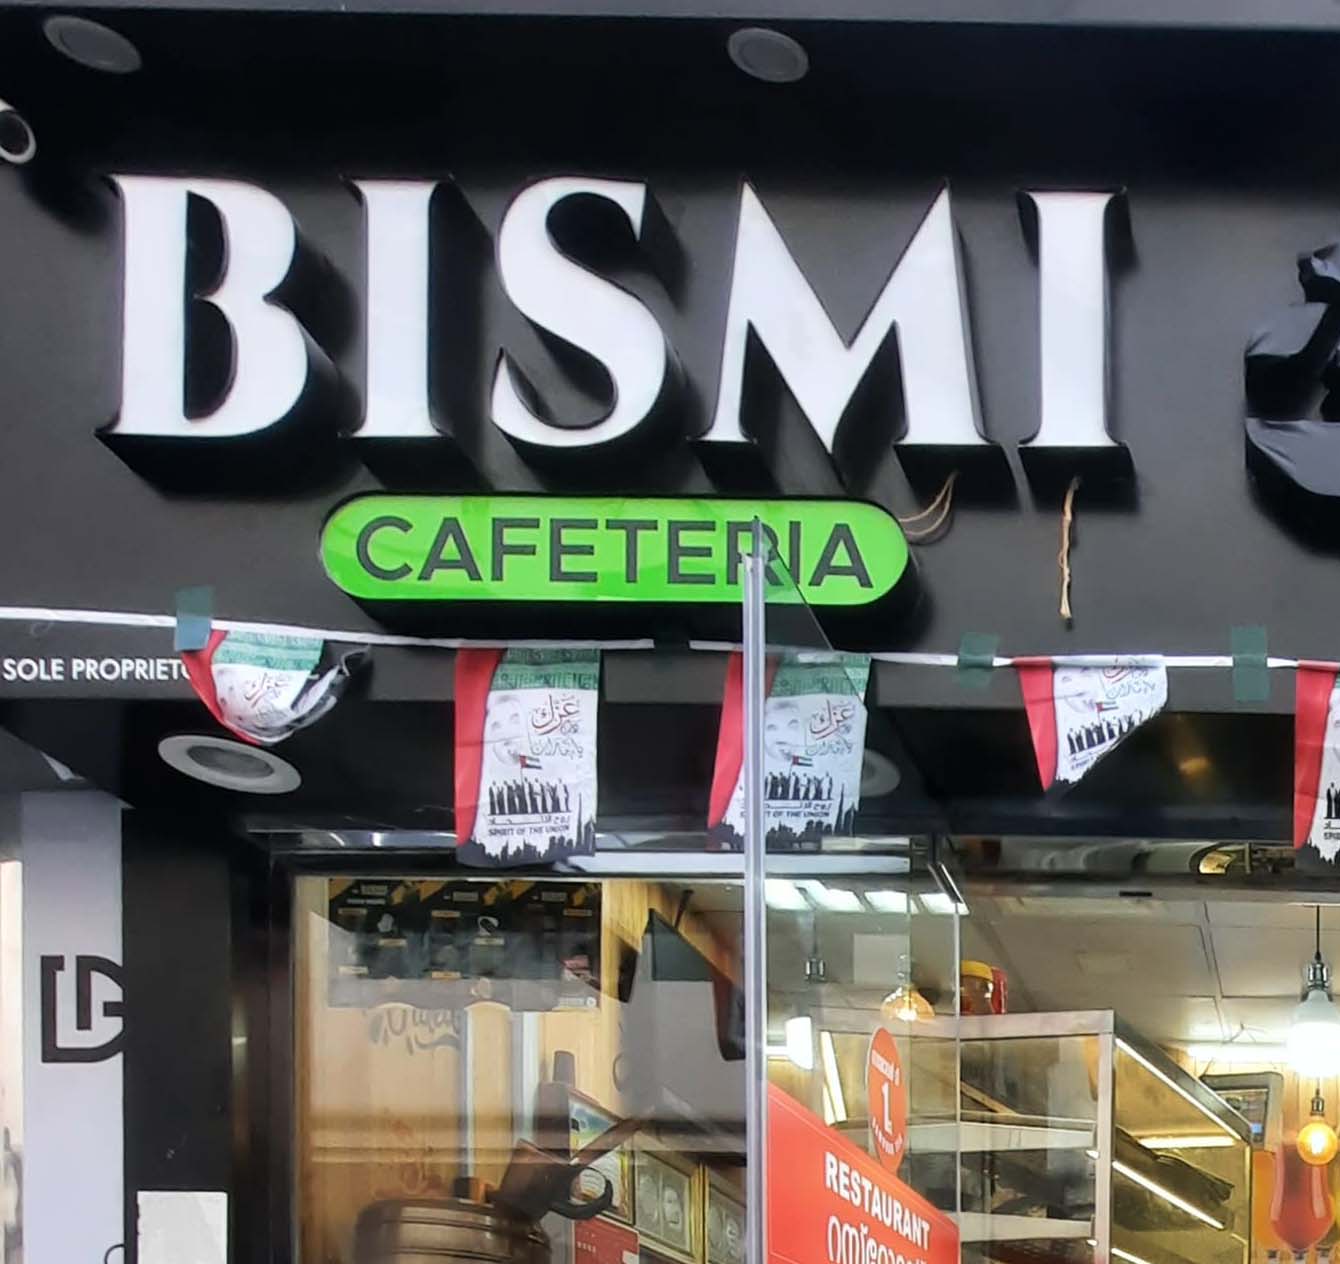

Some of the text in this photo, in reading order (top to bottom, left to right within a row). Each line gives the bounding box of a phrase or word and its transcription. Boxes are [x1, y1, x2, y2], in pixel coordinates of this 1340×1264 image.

[98, 174, 1127, 455] BISMI
[356, 516, 874, 589] CAFETERIA
[3, 658, 65, 681] SOLE
[824, 1150, 931, 1251] RESTAURANT
